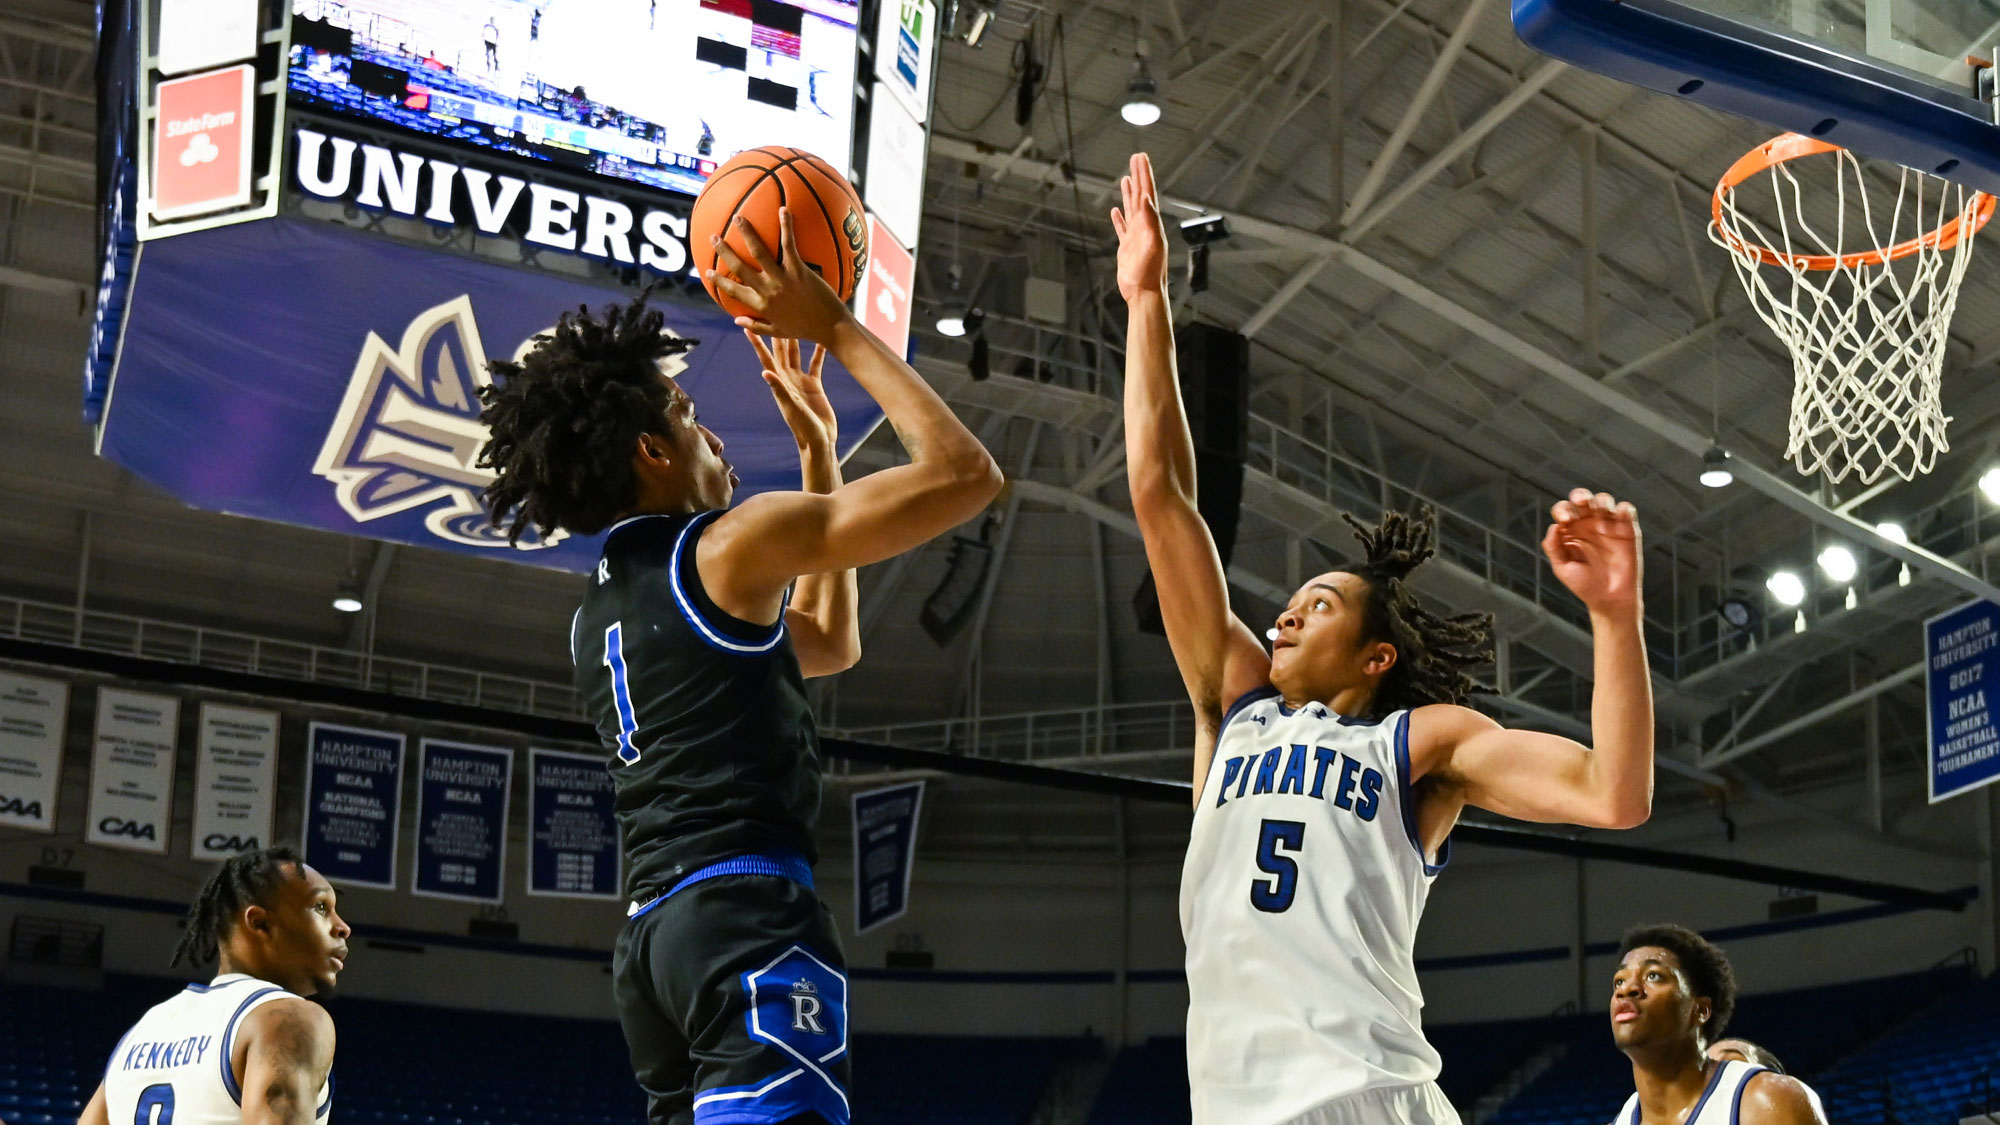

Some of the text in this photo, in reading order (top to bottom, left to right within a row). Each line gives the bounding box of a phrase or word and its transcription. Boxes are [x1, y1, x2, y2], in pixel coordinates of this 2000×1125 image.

[295, 129, 698, 276] UNIVERS
[597, 557, 611, 585] R
[1938, 616, 1991, 651] HAMPTON
[1933, 631, 1998, 670] UNIVERSITY
[1949, 663, 1984, 691] 2017
[603, 621, 641, 767] 1
[1948, 689, 1986, 720] NCAA
[1946, 711, 1989, 738] WOMEN'S
[322, 740, 392, 762] HAMPTON
[1938, 726, 1997, 758] BASKETBALL
[315, 752, 397, 774] UNIVERSITY
[431, 756, 500, 777] HAMPTON
[1937, 741, 2000, 775] TOURNAMENT
[336, 773, 374, 789] NCAA
[425, 768, 505, 790] UNIVERSITY
[535, 775, 613, 795] UNIVERSITY
[541, 764, 610, 783] HAMPTON
[1216, 744, 1383, 822] PIRATES
[324, 791, 383, 809] NATIONAL
[445, 788, 482, 805] NCAA
[557, 792, 595, 809] NCAA
[320, 802, 386, 821] CHAMPIONS
[99, 817, 156, 841] CAA
[42, 847, 75, 867] D7
[1250, 818, 1306, 913] 5
[789, 992, 826, 1034] R
[123, 1035, 213, 1071] KENNEDY
